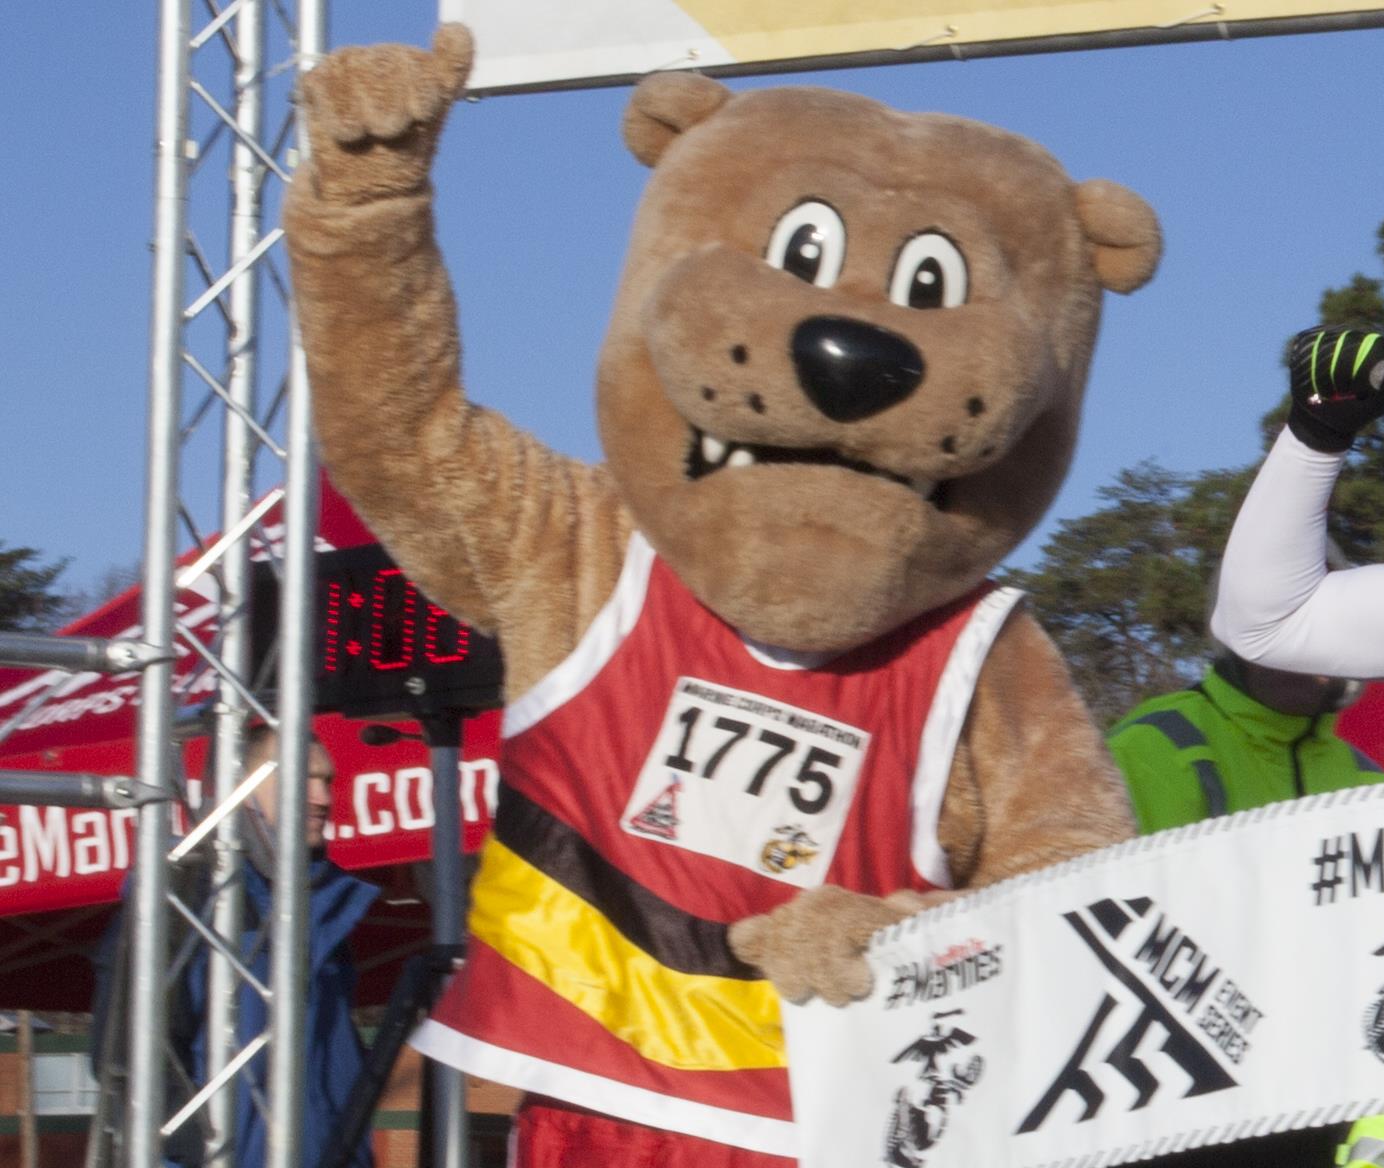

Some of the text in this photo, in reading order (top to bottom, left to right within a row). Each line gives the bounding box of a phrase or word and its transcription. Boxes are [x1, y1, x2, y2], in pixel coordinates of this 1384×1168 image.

[664, 706, 844, 815] 1775
[885, 945, 1002, 1009] #Marines
[1132, 912, 1222, 1014] MCM
